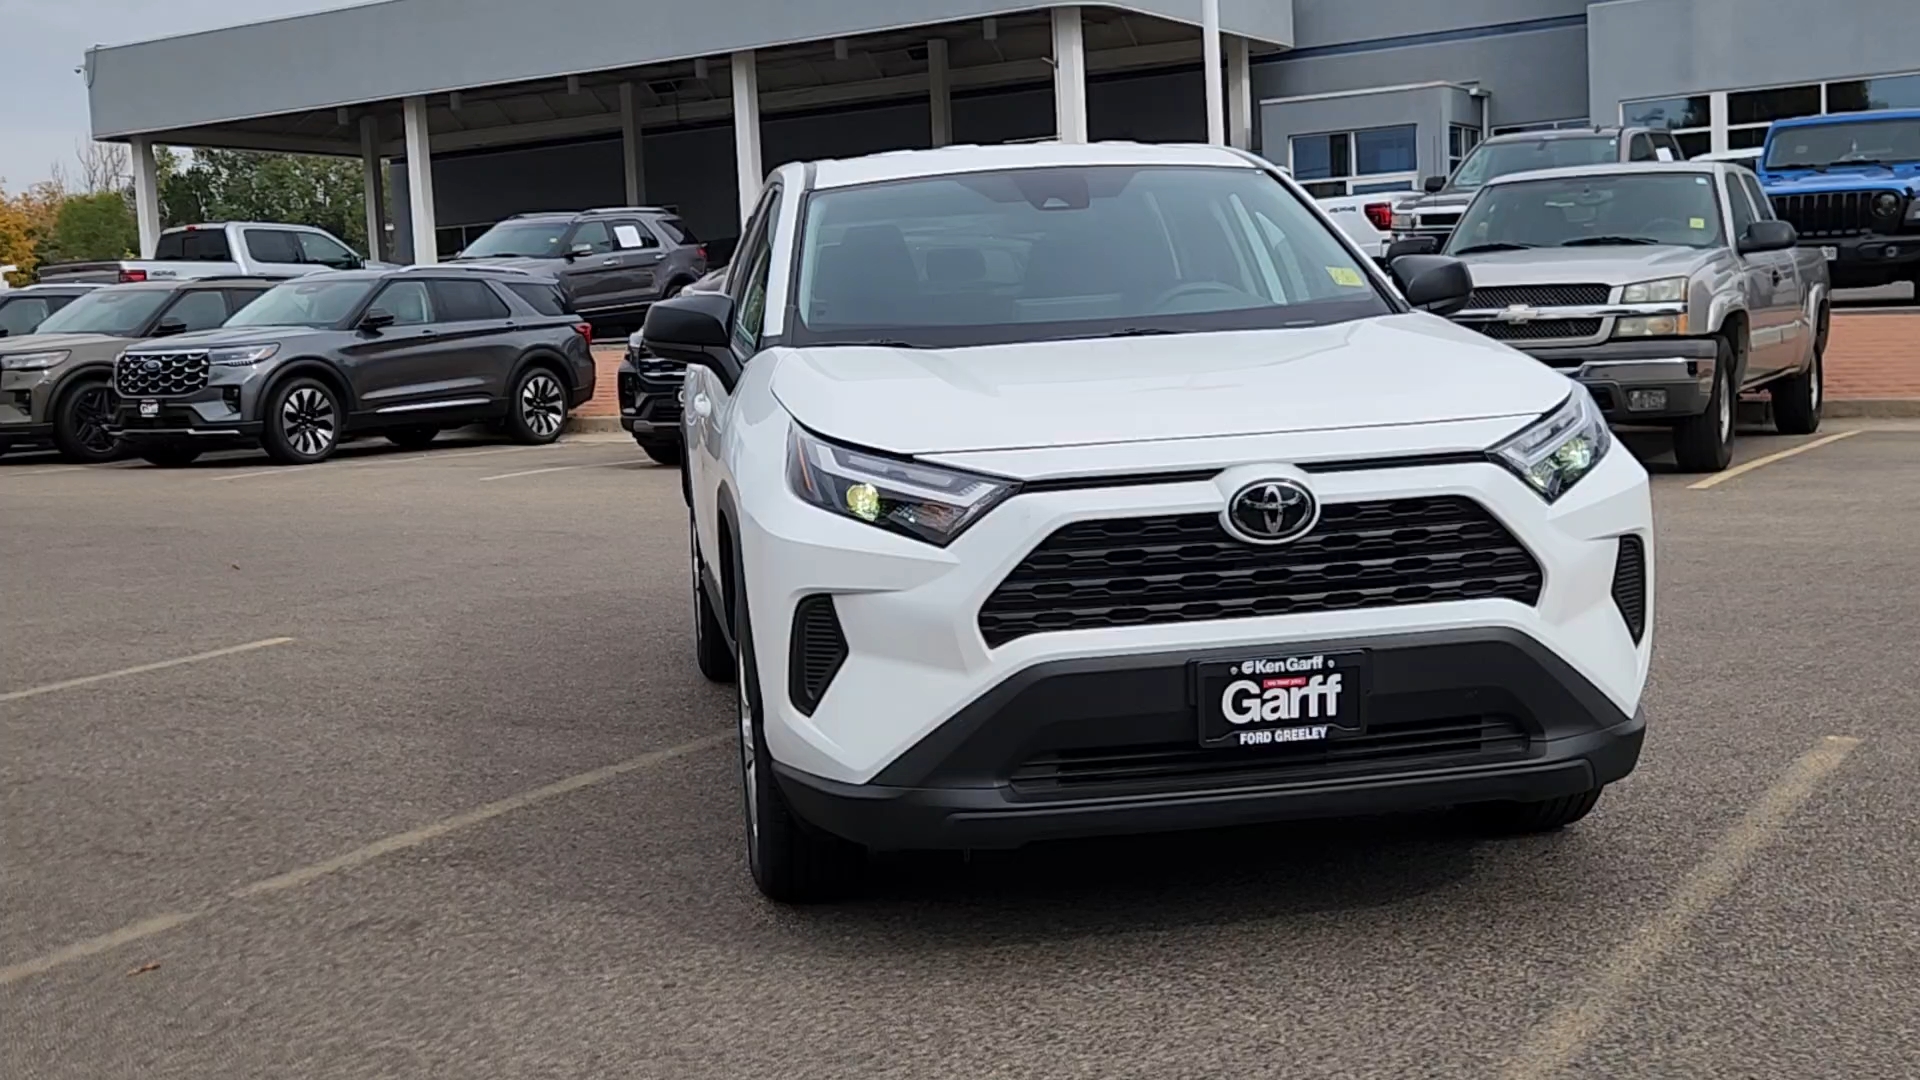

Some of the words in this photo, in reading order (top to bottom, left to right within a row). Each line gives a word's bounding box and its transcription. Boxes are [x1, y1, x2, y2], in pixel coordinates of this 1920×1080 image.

[1255, 659, 1285, 674] Ken
[1286, 655, 1324, 671] Garff
[1221, 673, 1342, 724] Garff
[1240, 732, 1272, 745] FORD
[1274, 726, 1328, 742] GREELEY
